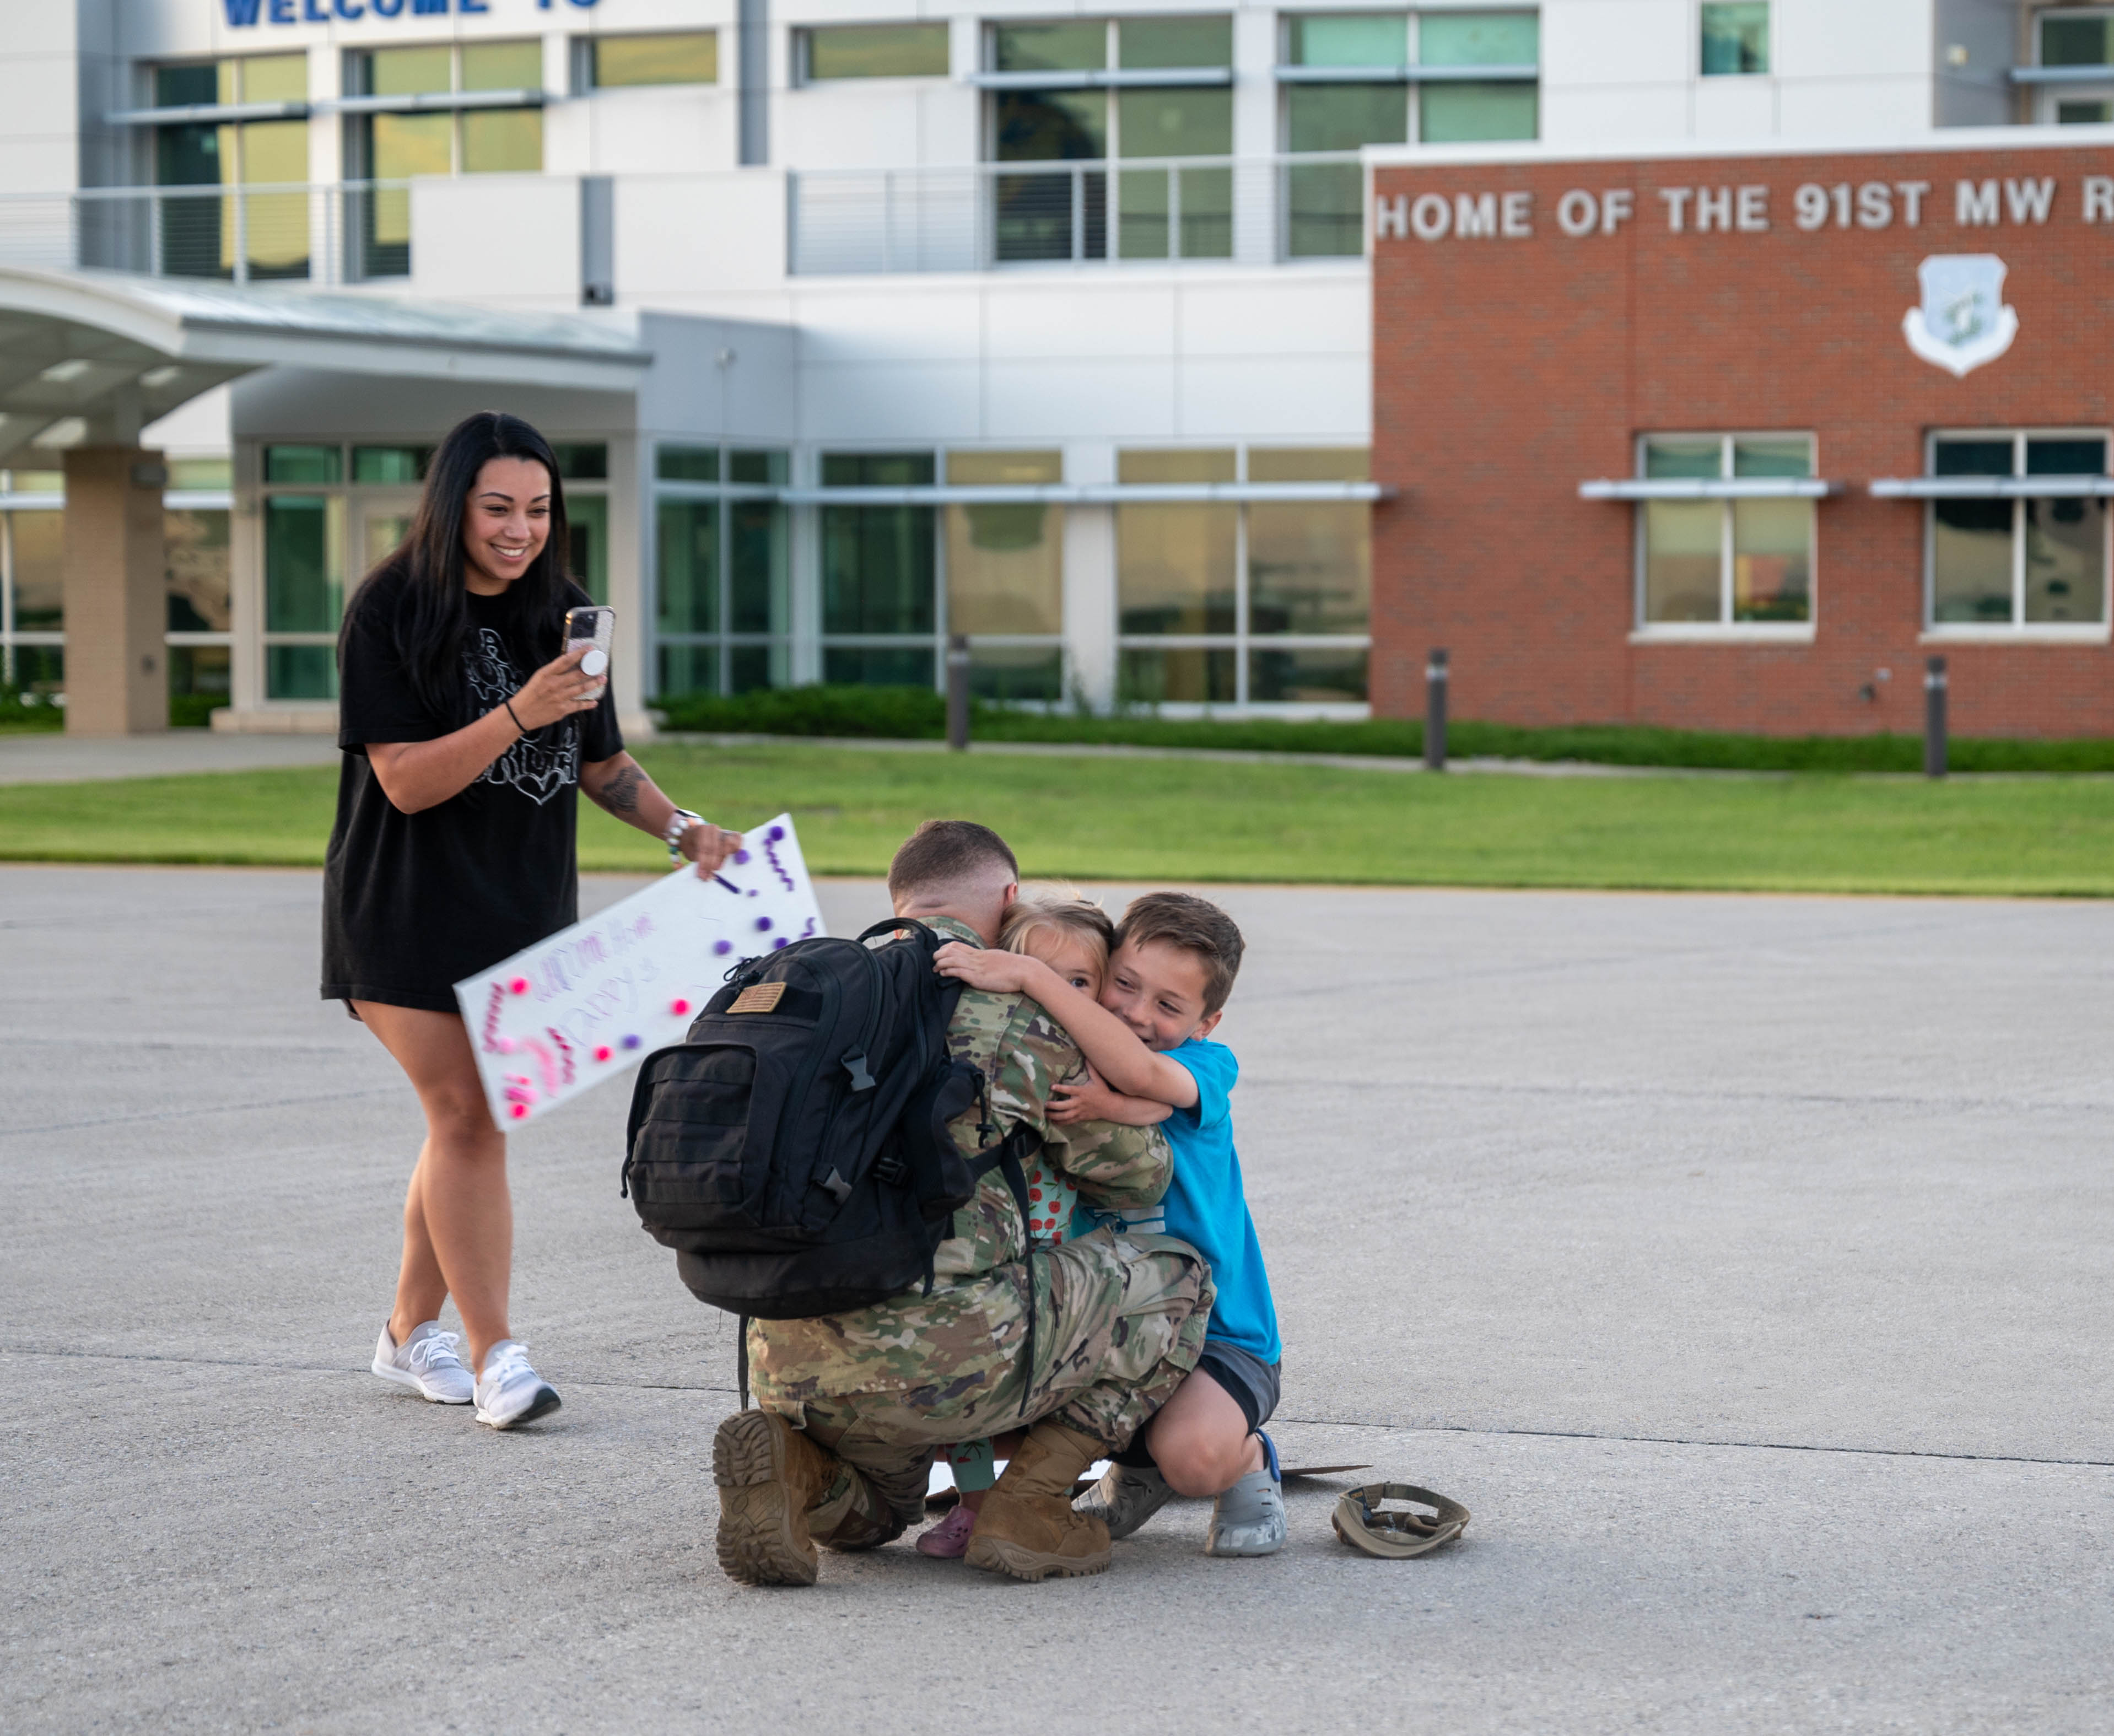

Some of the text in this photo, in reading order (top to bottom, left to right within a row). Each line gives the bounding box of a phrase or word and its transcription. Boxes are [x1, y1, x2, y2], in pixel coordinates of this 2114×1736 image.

[1377, 175, 2114, 241] HOME OF THE 91ST MW R
